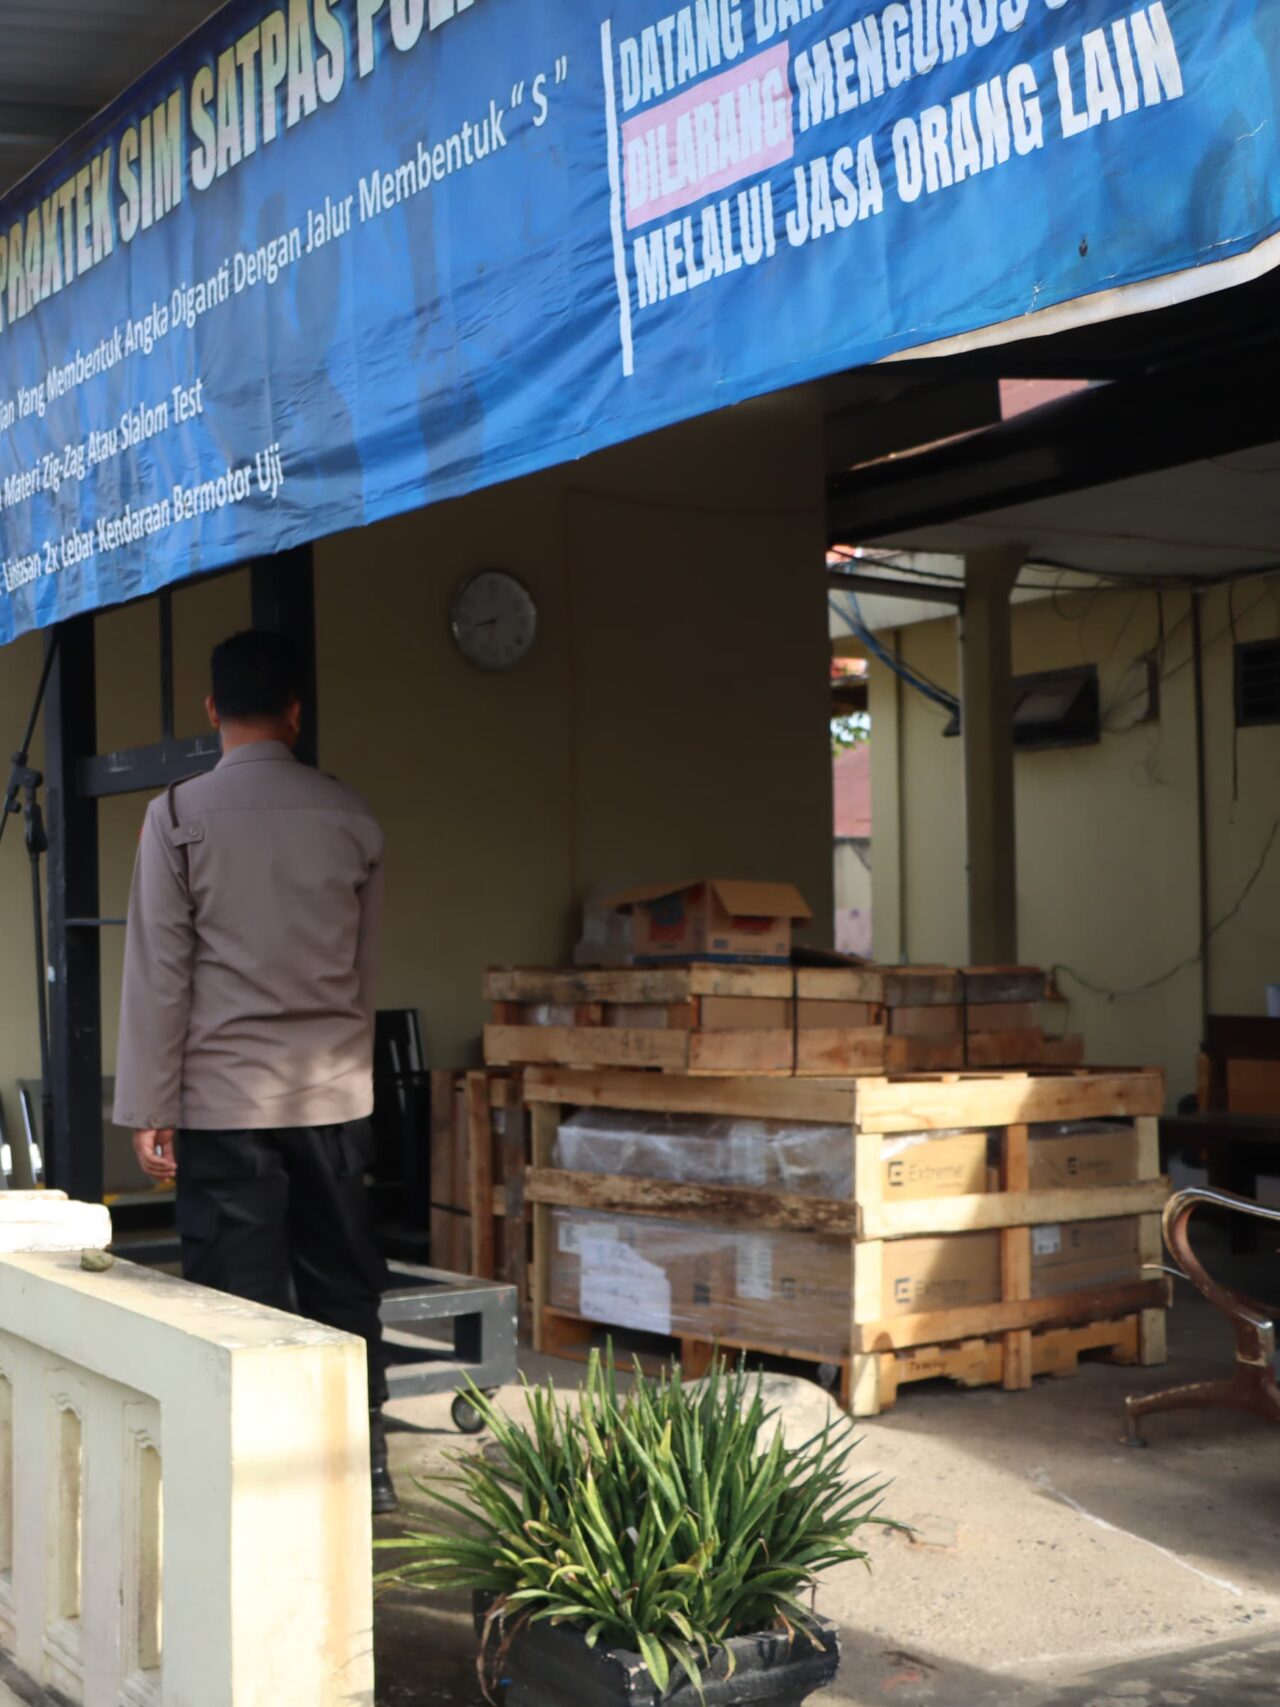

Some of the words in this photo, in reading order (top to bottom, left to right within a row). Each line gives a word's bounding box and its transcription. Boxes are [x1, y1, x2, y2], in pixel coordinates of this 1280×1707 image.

[119, 86, 181, 243] SIM
[190, 0, 345, 190] SATPAS
[620, 0, 744, 112] DATANG
[626, 67, 787, 211] DILARANG
[633, 181, 776, 309] MELALUI
[785, 135, 884, 247] JASA
[892, 63, 1044, 203] ORANG
[1053, 1, 1184, 139] LAIN
[17, 381, 46, 417] Yang
[46, 325, 122, 404] Membentuk
[124, 302, 168, 355] Angka
[171, 258, 229, 329] Diganti
[234, 225, 301, 285] Dengan
[305, 195, 354, 254] Jalur
[358, 99, 507, 223] Membentuk
[4, 457, 41, 506] Materi
[42, 444, 86, 493] Zig-Zag
[87, 430, 118, 468] Atau
[120, 402, 169, 451] Slalom
[172, 377, 204, 424] Test
[61, 526, 95, 566] Lebar
[97, 498, 172, 552] Kendaraan
[174, 463, 253, 524] Bermotor
[255, 443, 284, 499] Uji
